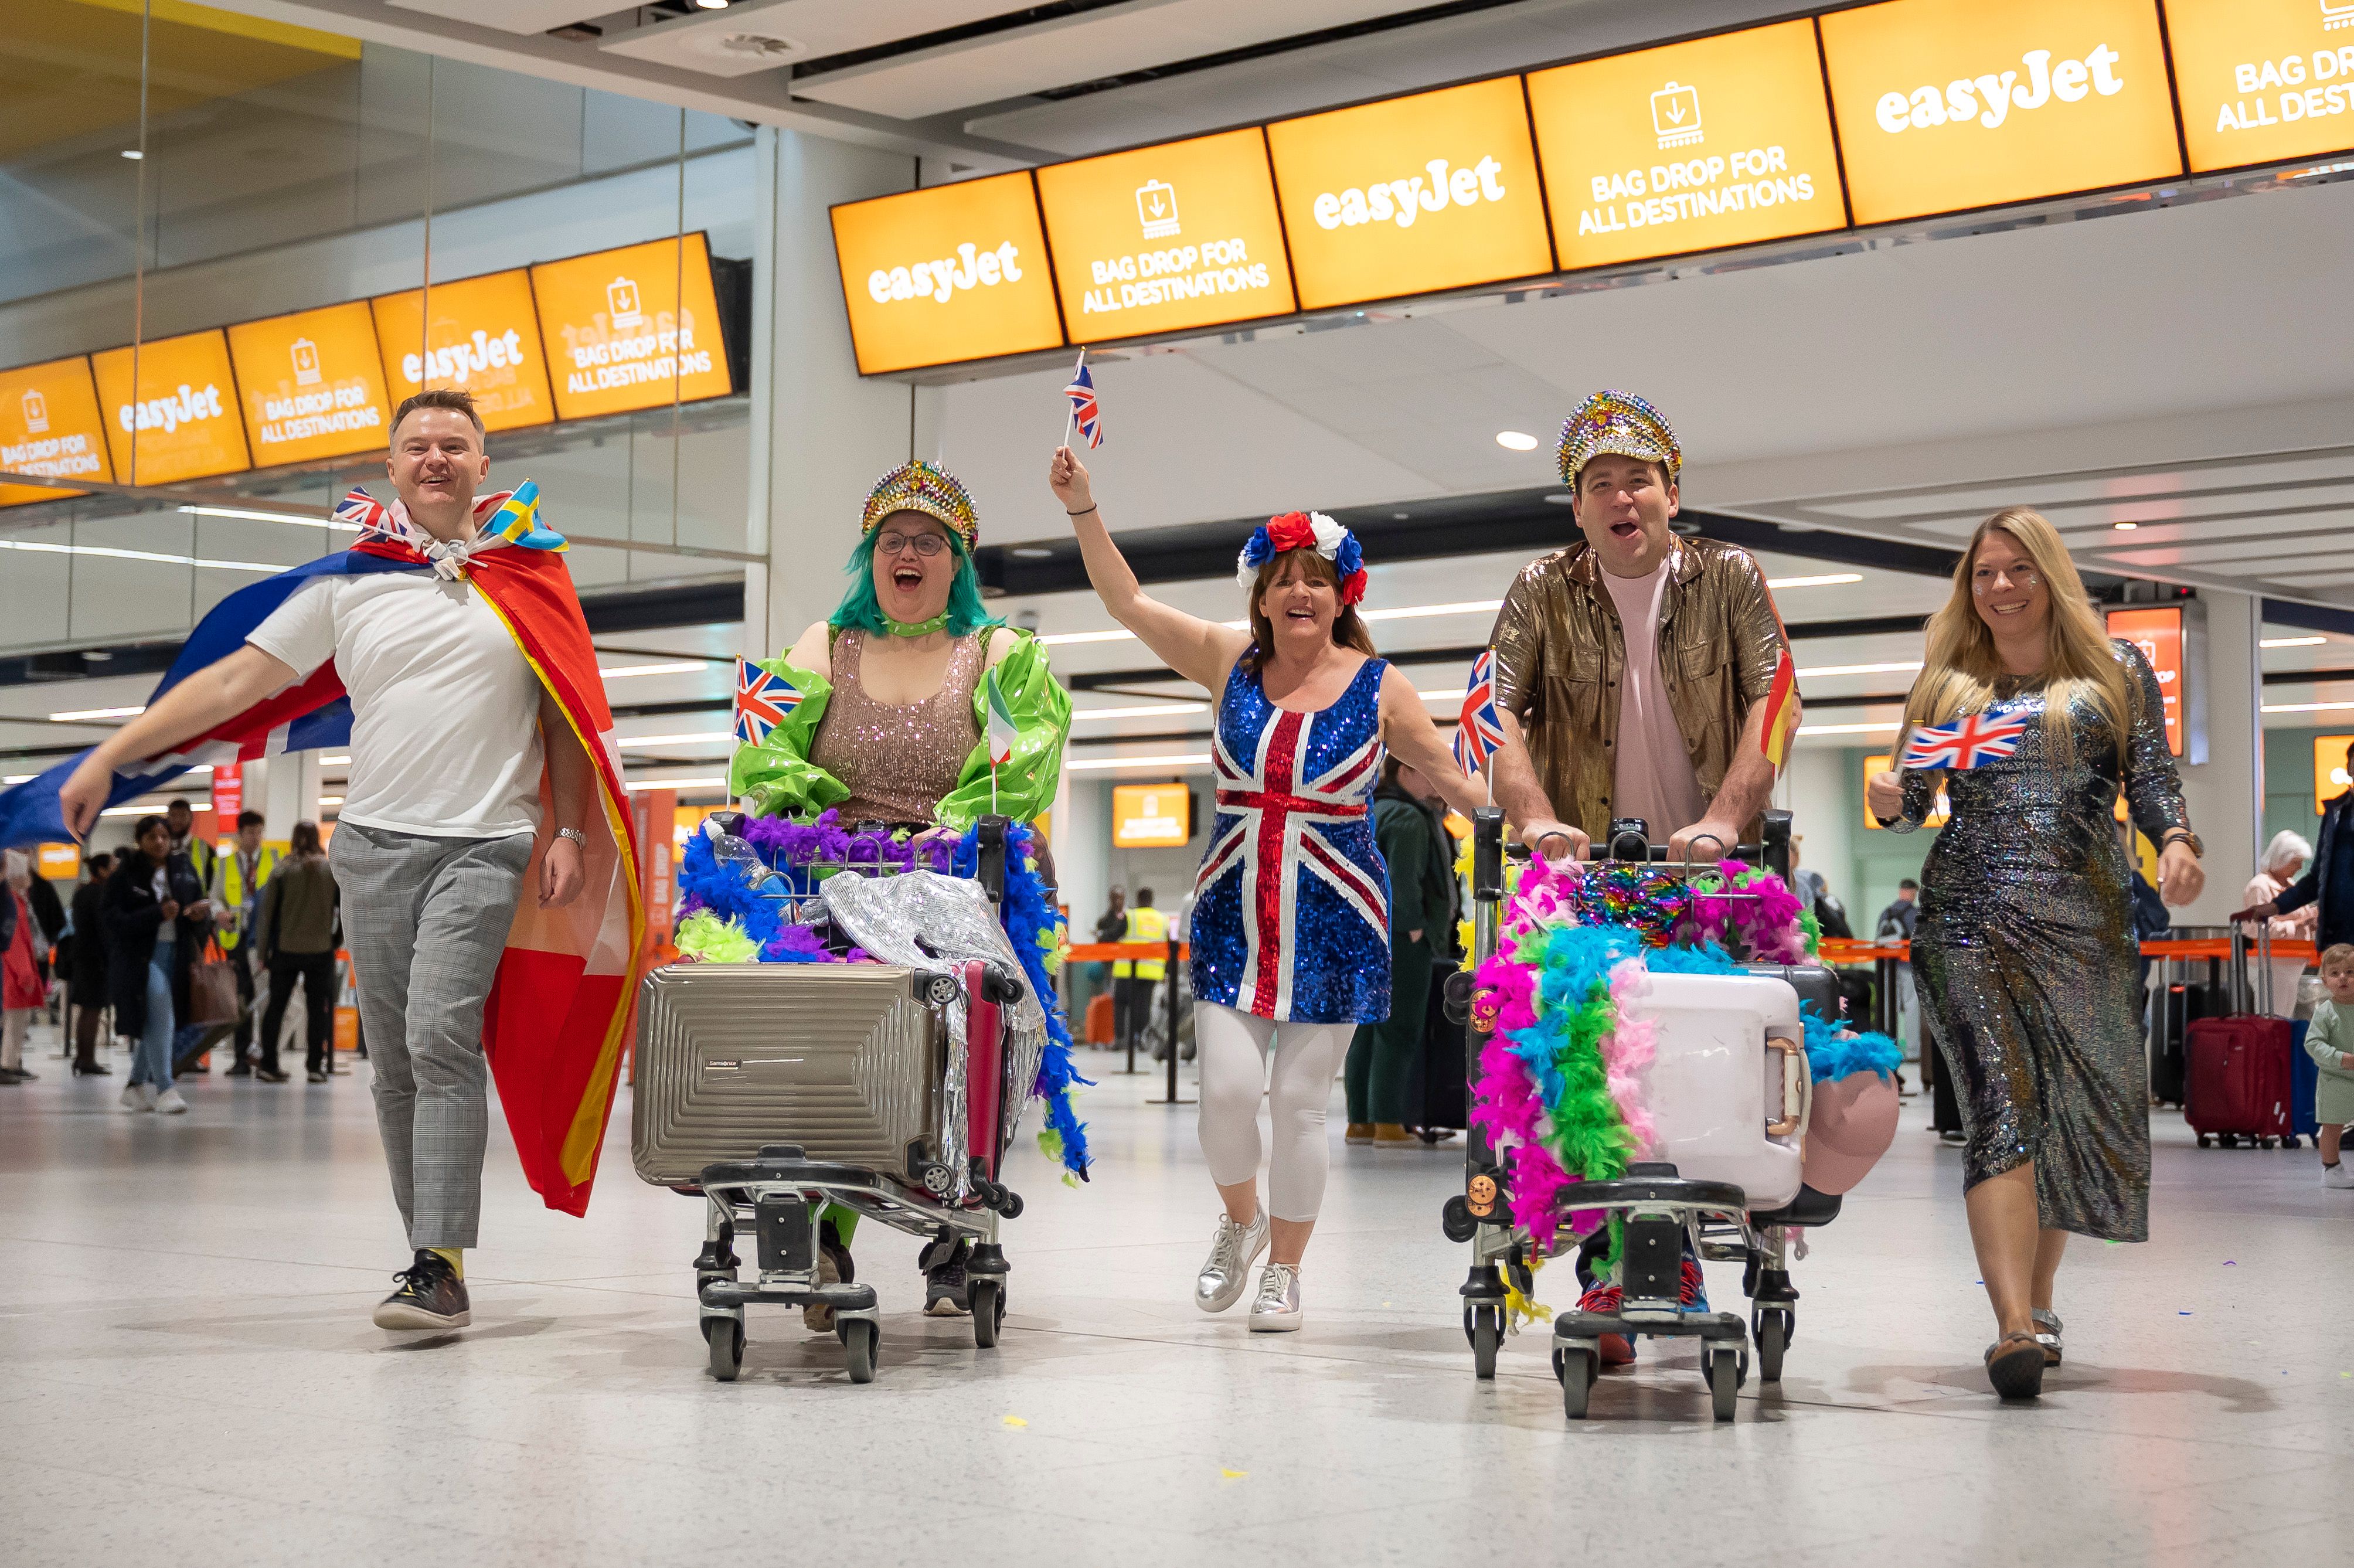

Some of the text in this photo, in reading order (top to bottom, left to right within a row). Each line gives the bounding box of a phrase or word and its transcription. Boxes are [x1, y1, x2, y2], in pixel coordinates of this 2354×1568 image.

[1876, 43, 2124, 133] easyJet
[2235, 55, 2307, 93] BAG
[2216, 97, 2278, 133] ALL
[1314, 155, 1505, 230] easyJet
[1591, 145, 1787, 202] BAG DROP FOR
[1579, 174, 1814, 236] ALL DESTINATIONS
[868, 240, 1022, 303] easyJet
[1091, 238, 1247, 285] BAG DROP FOR
[1083, 263, 1270, 314] ALL DESTINATIONS
[403, 328, 523, 383] easyJet
[568, 351, 712, 394] ALL DESTINATIONS
[574, 328, 695, 368] BAG DROP FOR
[120, 383, 223, 434] easyJet
[261, 407, 380, 444] ALL DESTINATIONS
[265, 386, 365, 421] BAG DROP FOR
